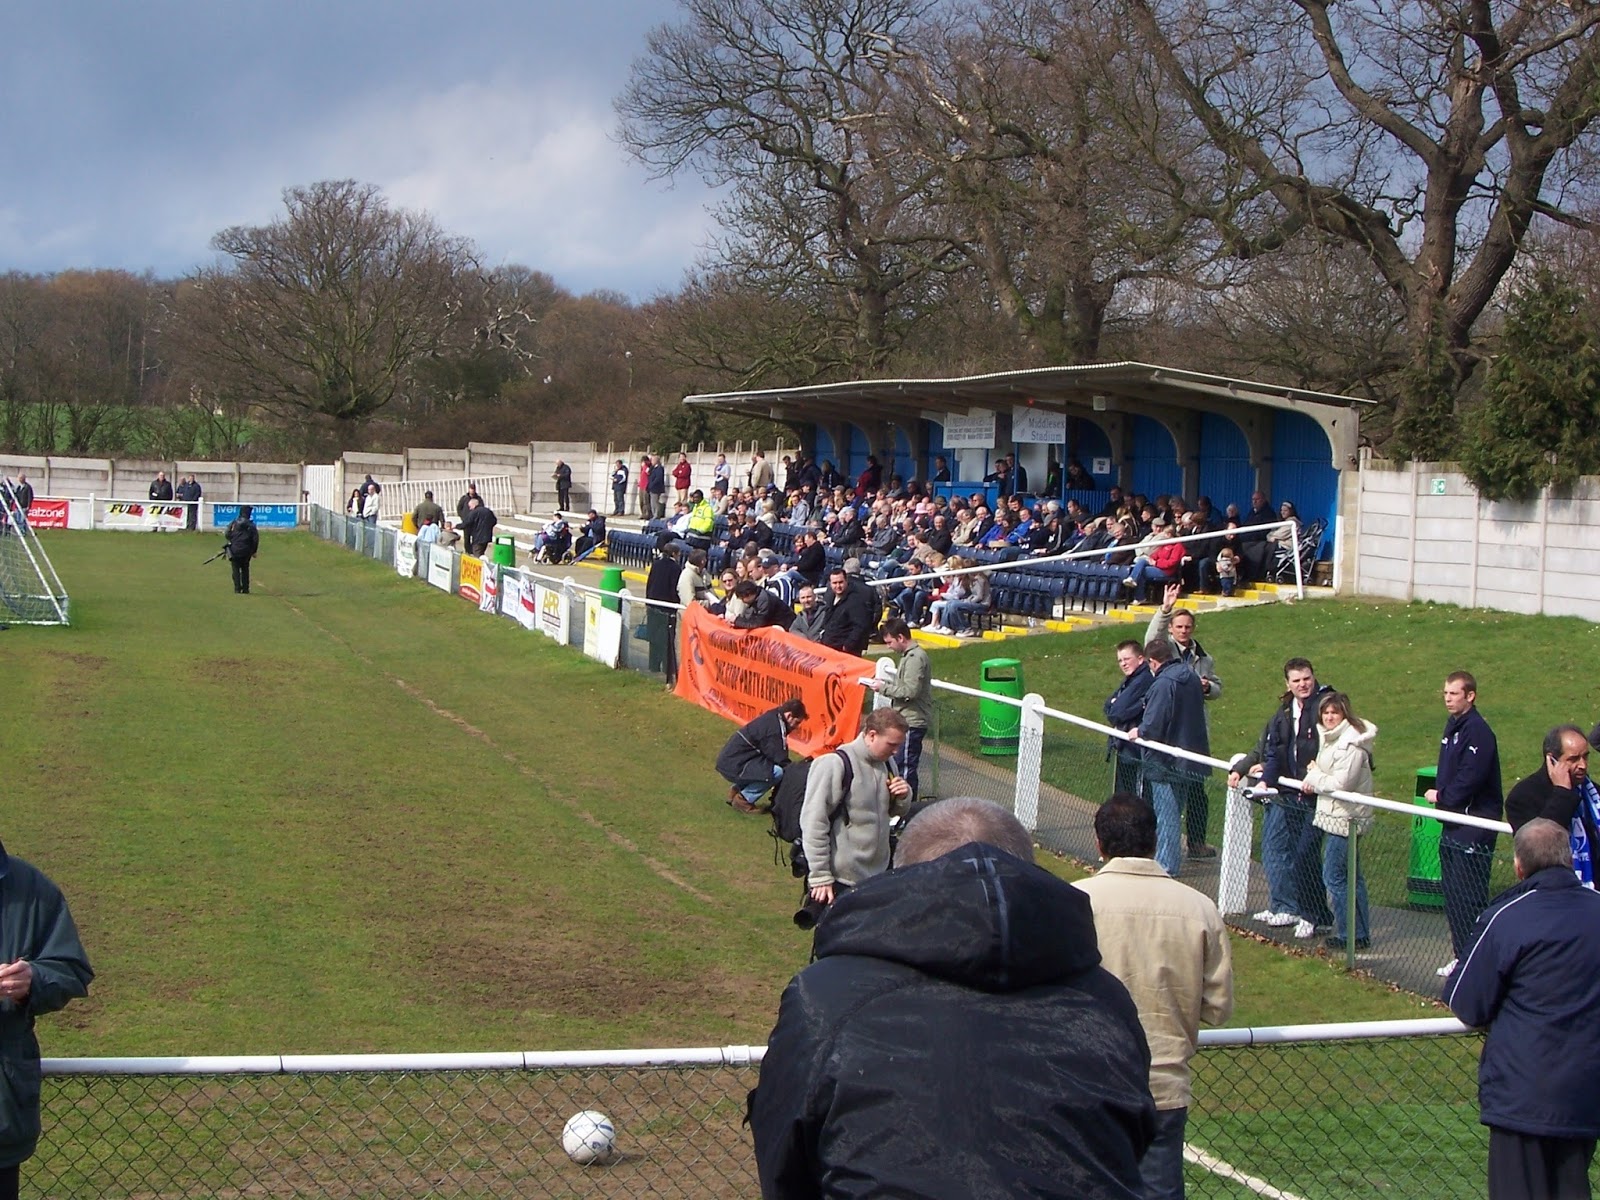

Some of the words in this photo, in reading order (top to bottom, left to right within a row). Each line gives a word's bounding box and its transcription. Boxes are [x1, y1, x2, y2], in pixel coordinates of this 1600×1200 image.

[1028, 417, 1065, 429] Middlesex
[1031, 430, 1063, 442] Stadium
[110, 504, 142, 514] FULL
[150, 505, 183, 515] TIME
[277, 505, 294, 514] Ltd
[544, 589, 560, 616] APR
[739, 667, 761, 698] PARTY
